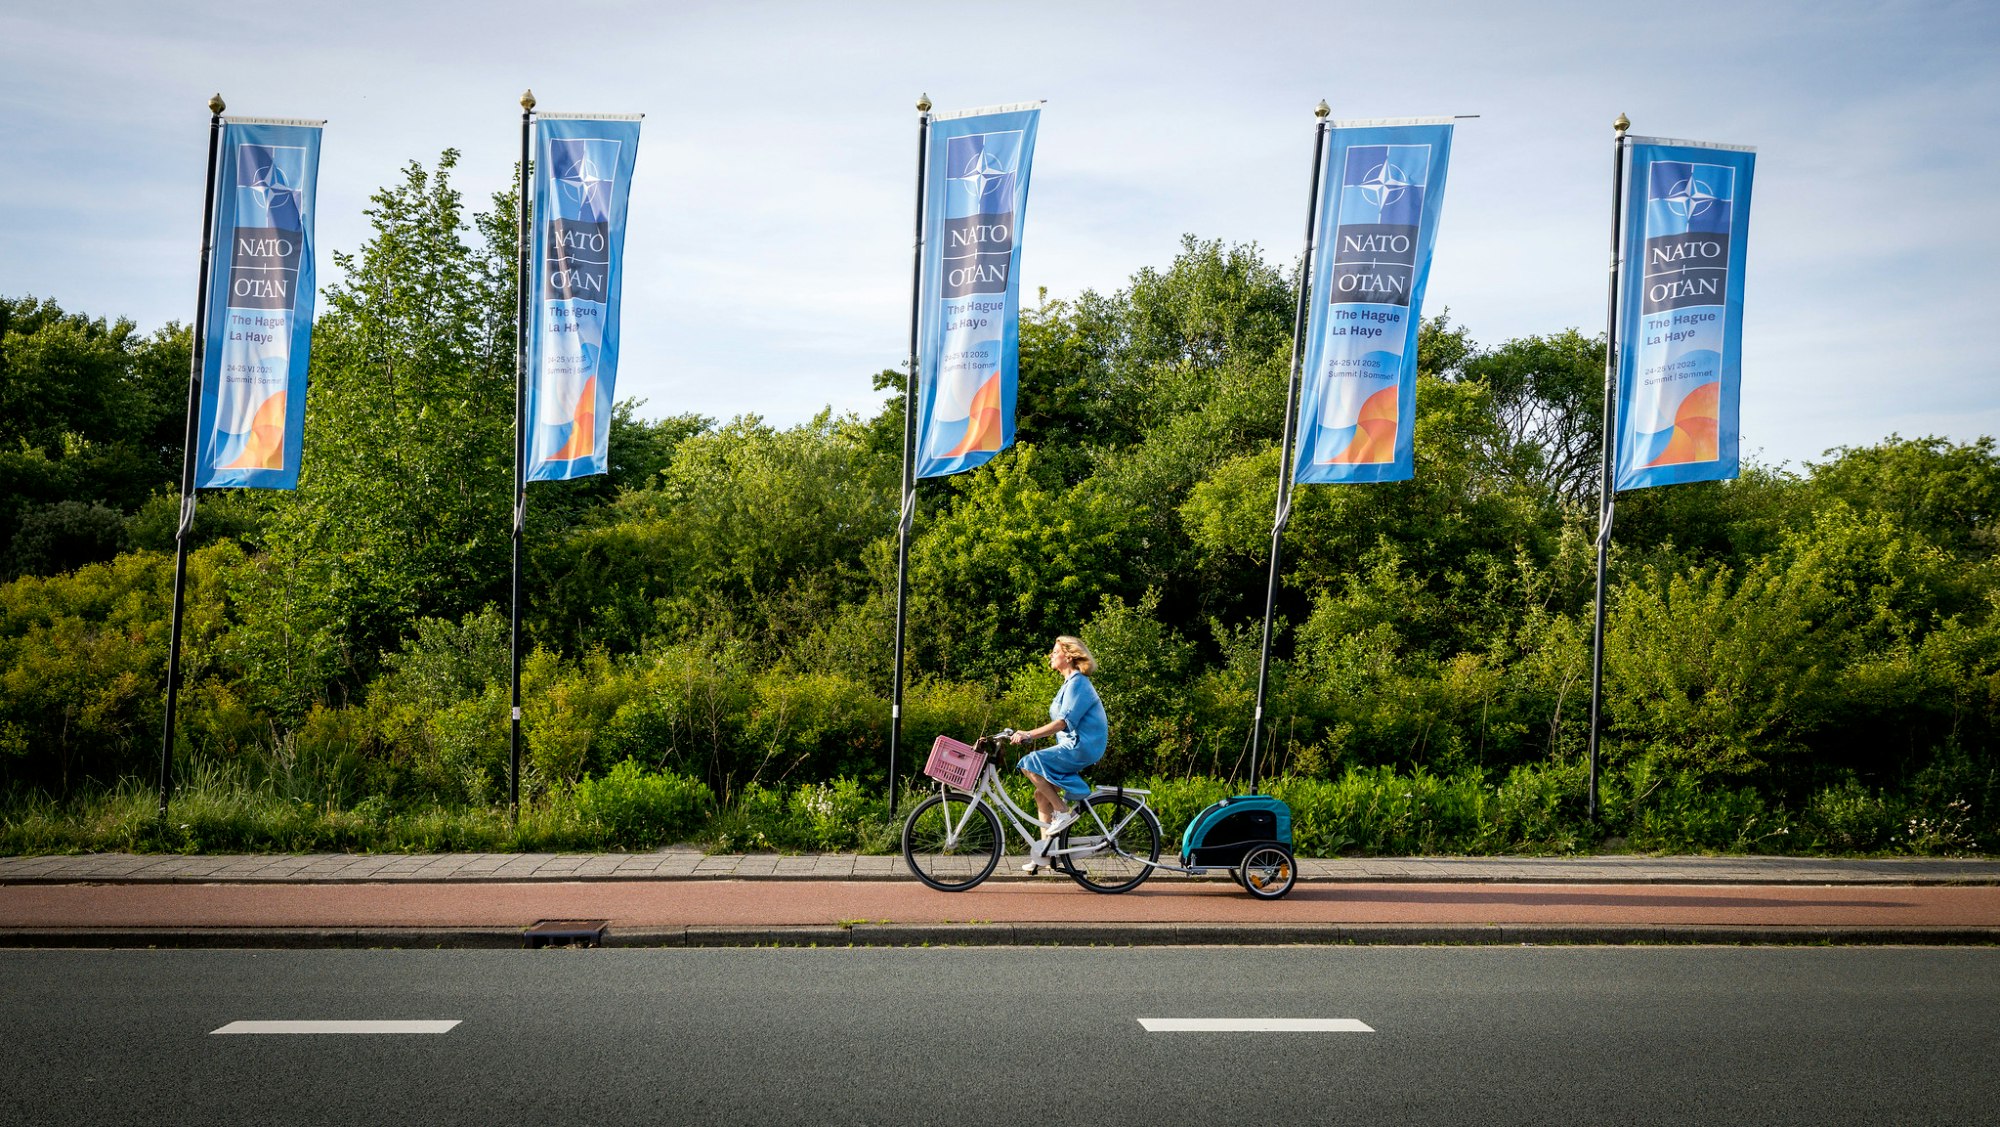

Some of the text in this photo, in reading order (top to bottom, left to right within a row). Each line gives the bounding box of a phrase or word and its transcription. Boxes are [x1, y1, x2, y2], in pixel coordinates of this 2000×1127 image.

[554, 229, 605, 252] NATO
[950, 224, 1008, 248] NATO
[1344, 234, 1410, 253] NATO
[238, 238, 293, 257] NATO
[1651, 241, 1720, 265] NATO
[948, 264, 1007, 287] OTAN
[234, 278, 289, 298] OTAN
[1338, 273, 1405, 294] OTAN
[1650, 278, 1718, 303] OTAN
[549, 307, 569, 317] The
[948, 301, 1003, 315] The Hague
[232, 315, 285, 330] The Hague
[1336, 310, 1400, 323] The Hague
[1648, 312, 1716, 330] The Hague
[549, 323, 560, 333] La
[946, 318, 987, 331] La Haye
[230, 332, 273, 345] La Haye
[1333, 326, 1382, 339] La Haye
[1647, 329, 1695, 346] La Haye
[1329, 359, 1350, 367] 24-25
[1362, 359, 1381, 368] 2025
[1645, 360, 1697, 375] 24-25 VI 2025
[1328, 370, 1394, 380] Summit Sommet
[1644, 370, 1713, 385] Summit Sommet
